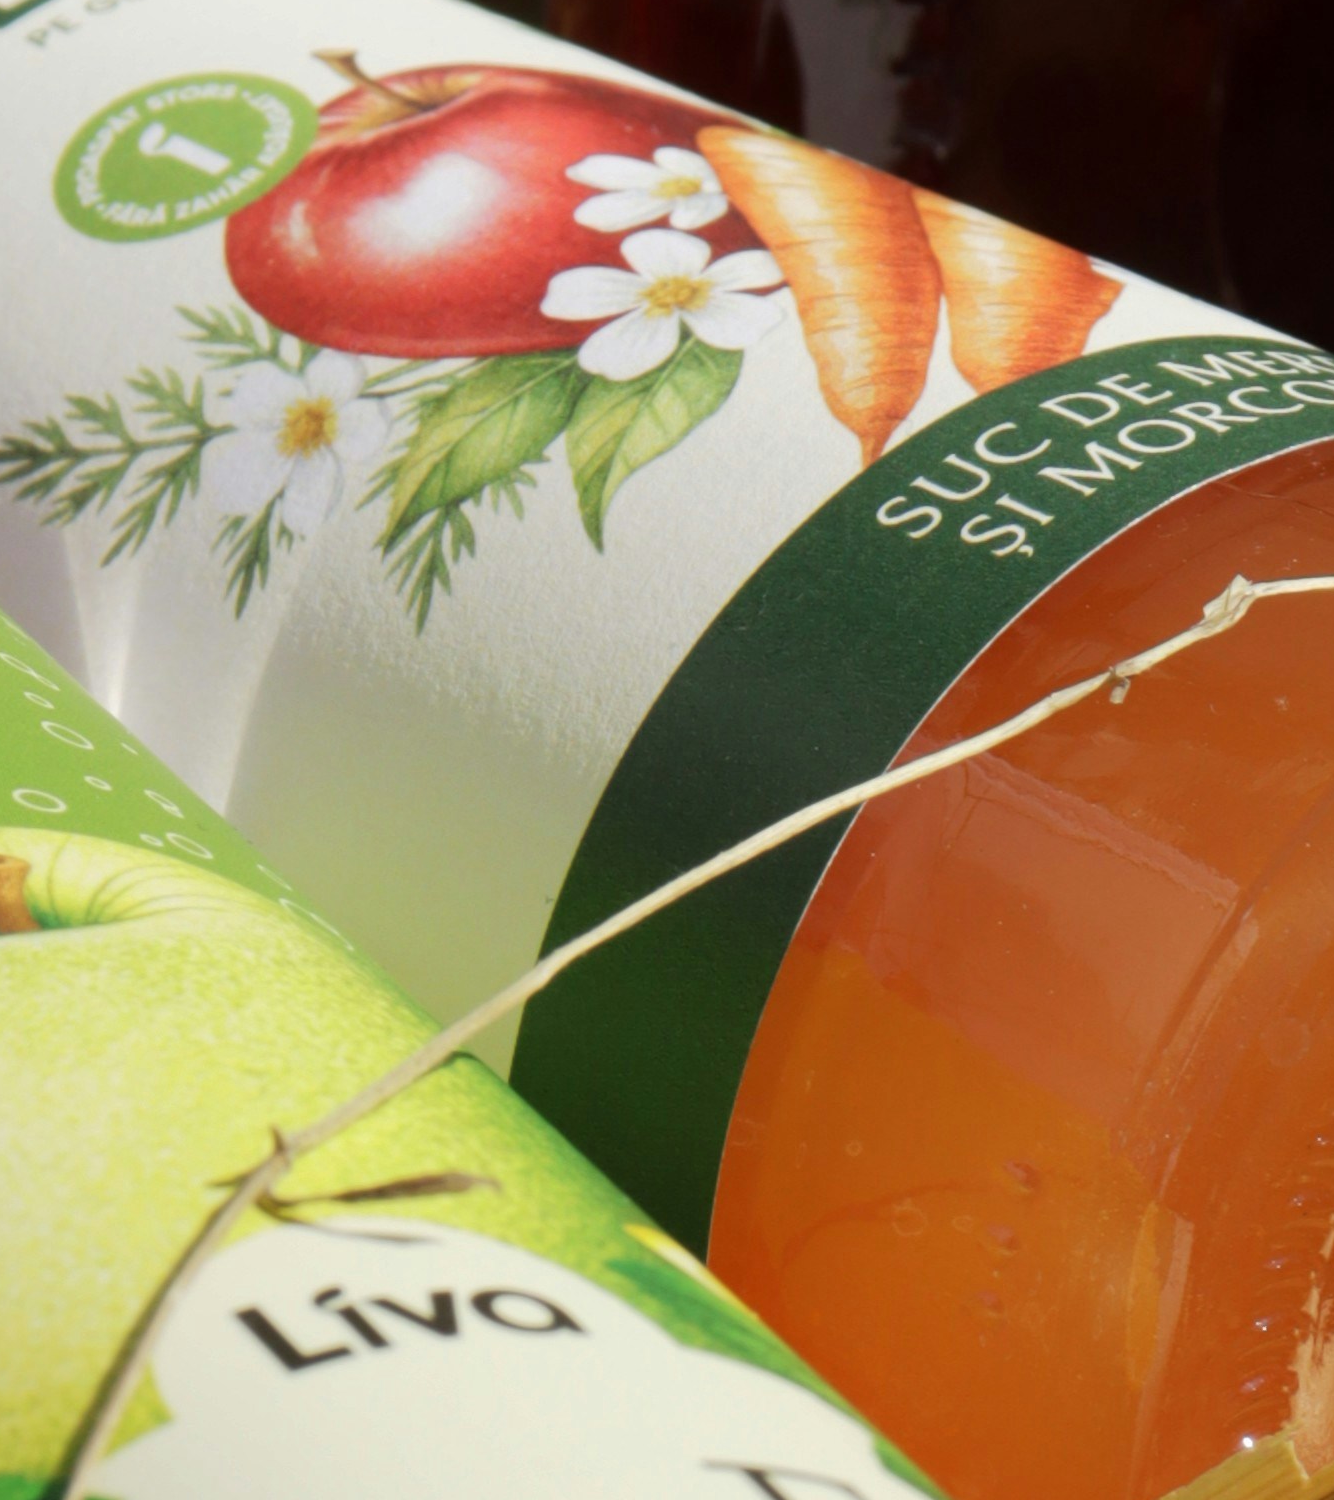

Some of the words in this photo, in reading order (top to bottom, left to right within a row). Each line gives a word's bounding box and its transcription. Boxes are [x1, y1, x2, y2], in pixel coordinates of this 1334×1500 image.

[875, 421, 1053, 539] SUC
[1037, 372, 1174, 429] DE
[959, 492, 1056, 559] ȘI
